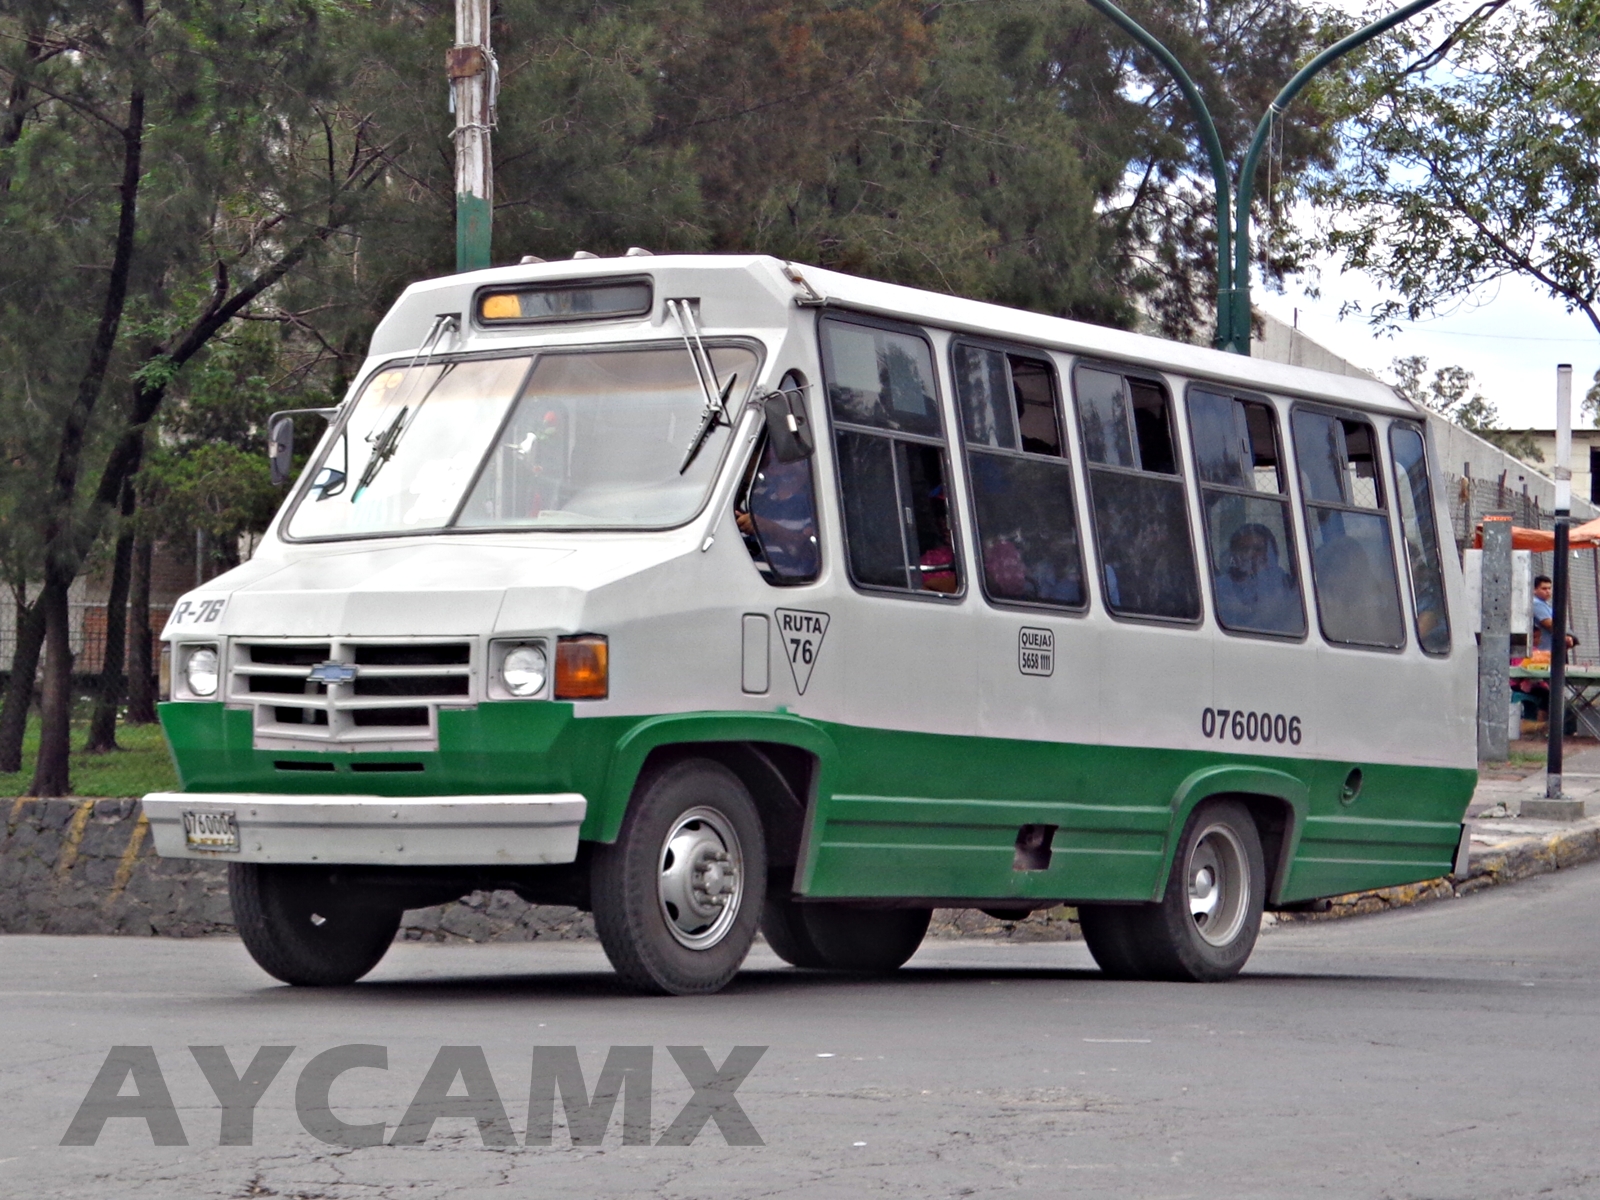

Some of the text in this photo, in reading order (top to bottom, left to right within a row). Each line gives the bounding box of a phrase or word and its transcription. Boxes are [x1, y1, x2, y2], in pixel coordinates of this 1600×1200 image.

[170, 599, 226, 625] R-76
[783, 614, 822, 635] RUTA
[1021, 632, 1052, 647] QUEJAS
[790, 638, 813, 665] 76
[1022, 652, 1039, 670] 5658
[1202, 707, 1302, 746] 0760006
